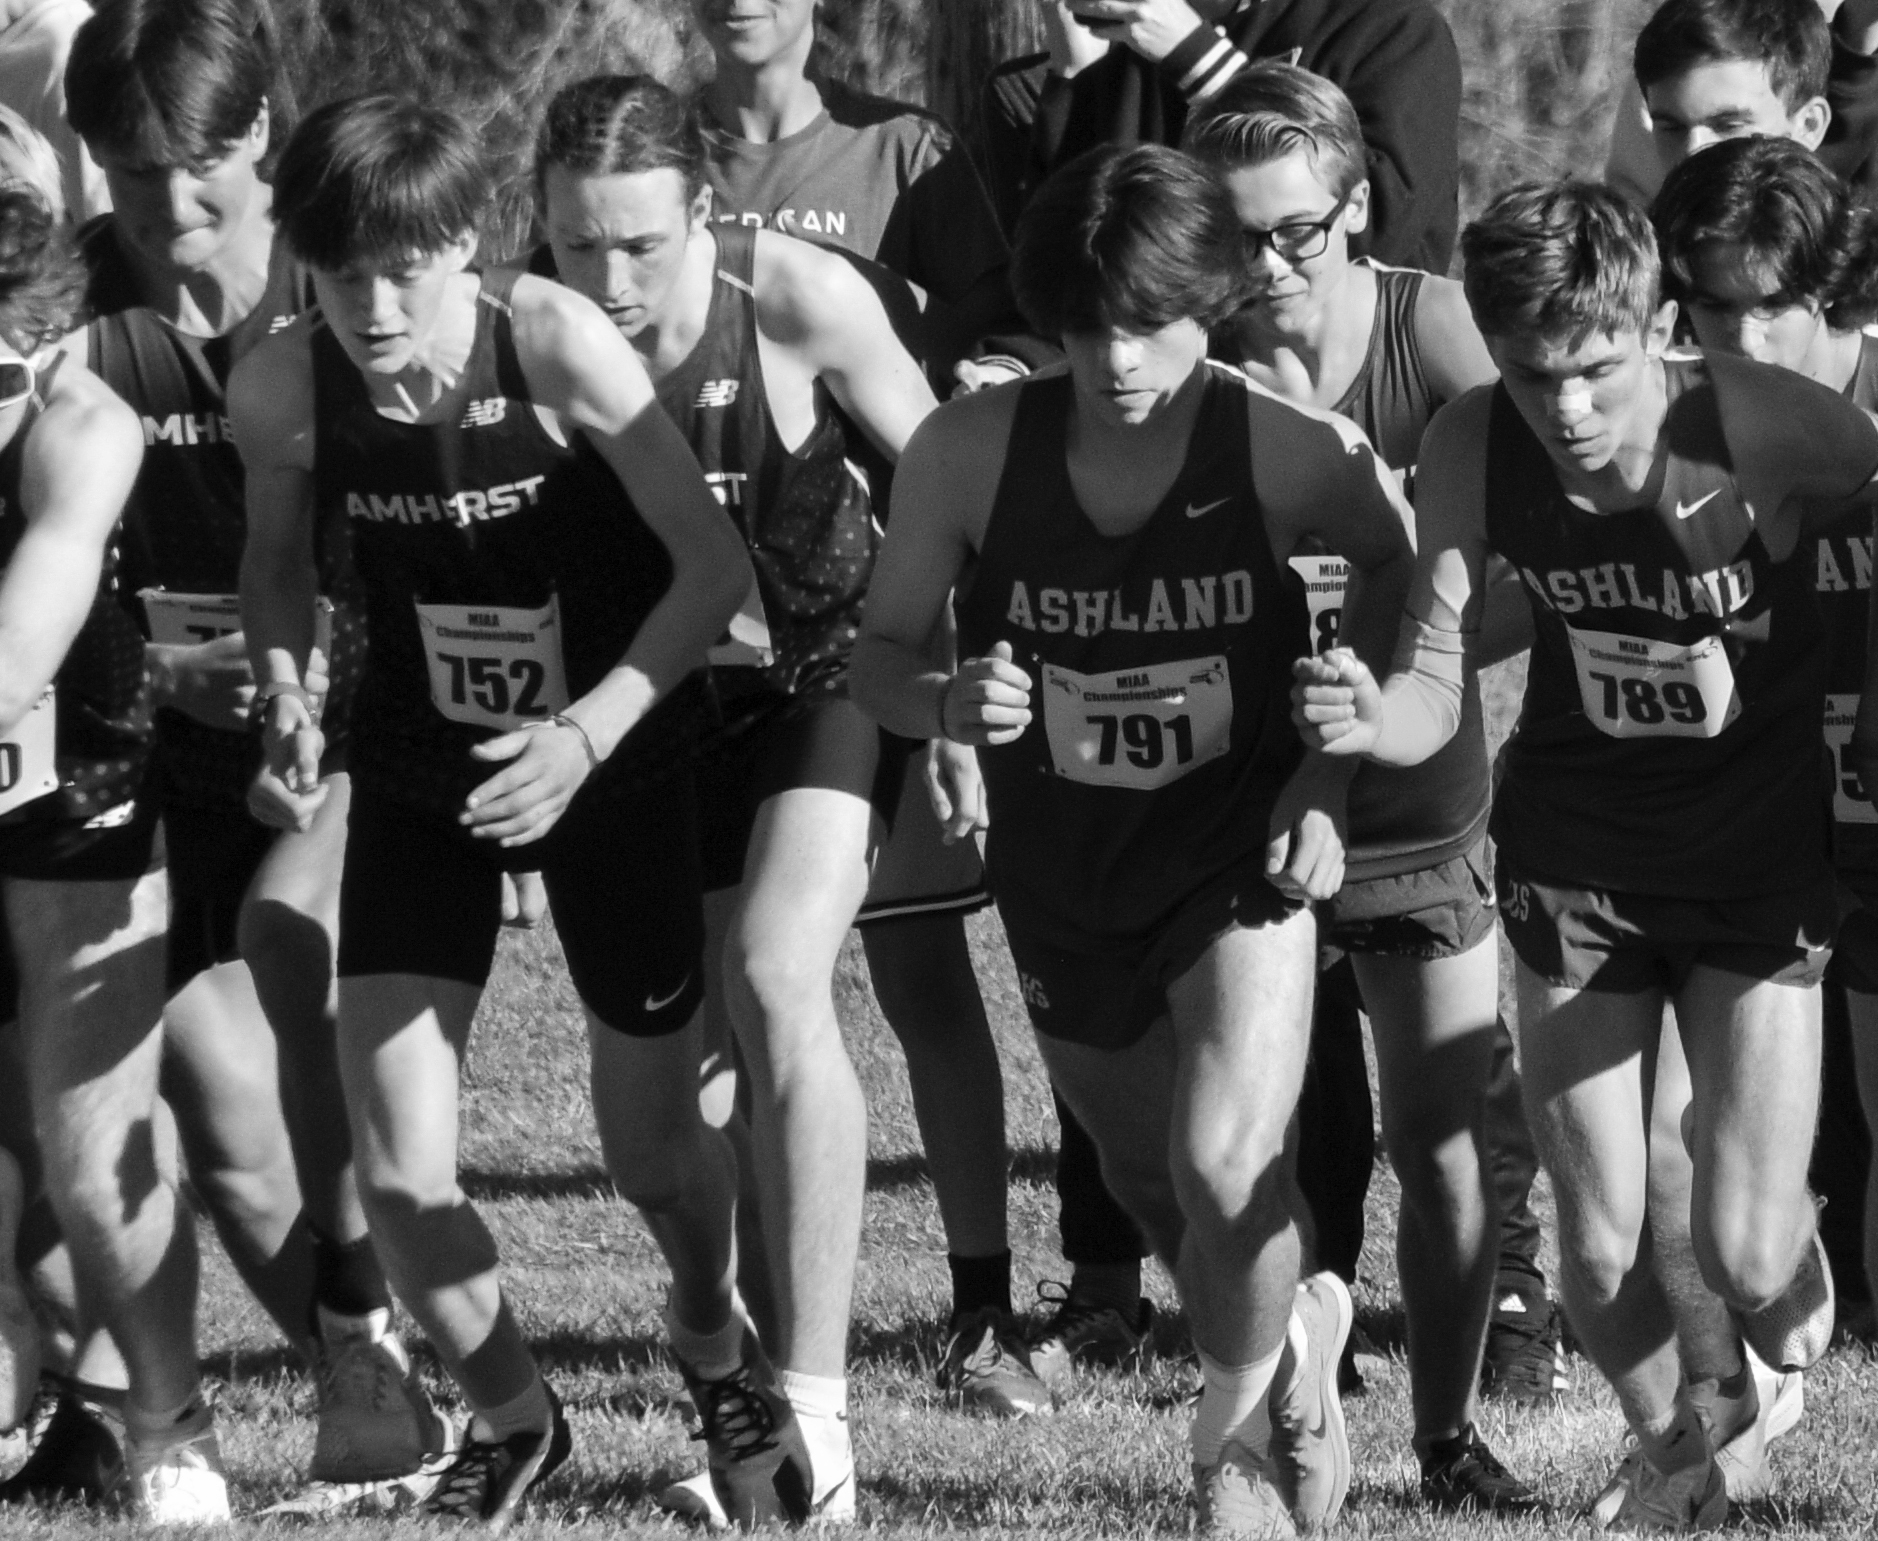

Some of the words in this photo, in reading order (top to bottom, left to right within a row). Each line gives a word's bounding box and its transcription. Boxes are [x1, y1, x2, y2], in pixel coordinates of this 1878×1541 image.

[347, 474, 545, 529] AMHERST
[1007, 569, 1254, 638] ASHLAND
[1521, 560, 1754, 620] ASHLAND
[436, 651, 549, 717] 752
[1589, 670, 1708, 724] 789
[1086, 713, 1195, 770] 791
